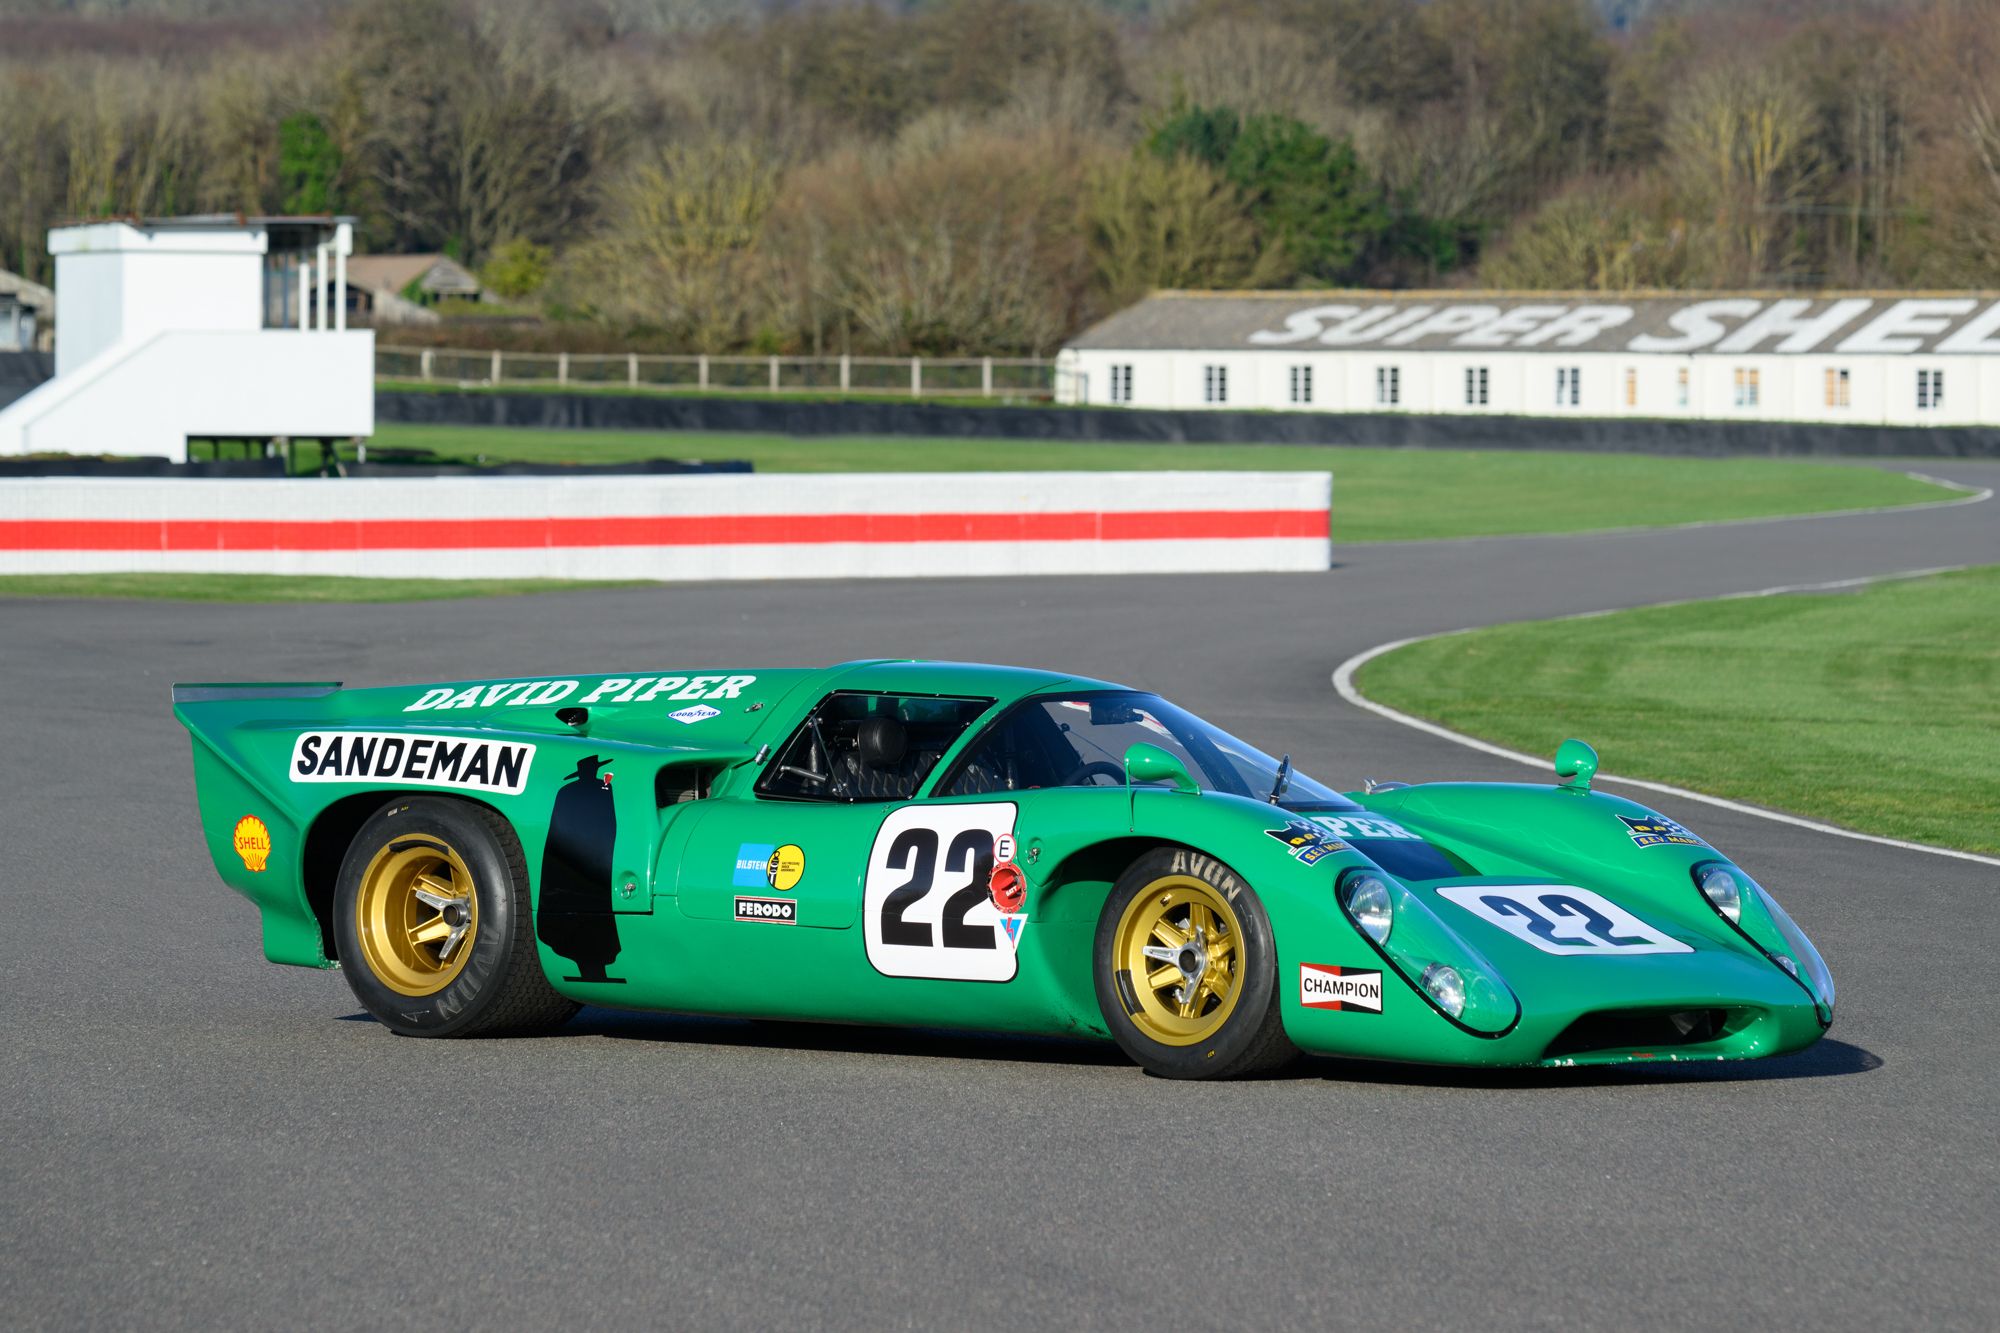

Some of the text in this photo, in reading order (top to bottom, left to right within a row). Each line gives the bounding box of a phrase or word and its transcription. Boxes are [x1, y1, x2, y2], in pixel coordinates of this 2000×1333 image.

[1247, 304, 1635, 347] SUPER
[402, 675, 757, 712] DAVID PIPER
[297, 735, 528, 788] SANDEMAN
[1309, 816, 1423, 839] PER
[238, 836, 267, 850] SHELL
[999, 839, 1011, 858] E
[736, 859, 768, 871] BILSTEIN
[1170, 851, 1242, 904] AVON
[881, 828, 996, 950] 22
[738, 902, 793, 918] FERODO
[1479, 894, 1657, 947] 22
[1303, 977, 1380, 999] CHAMPION
